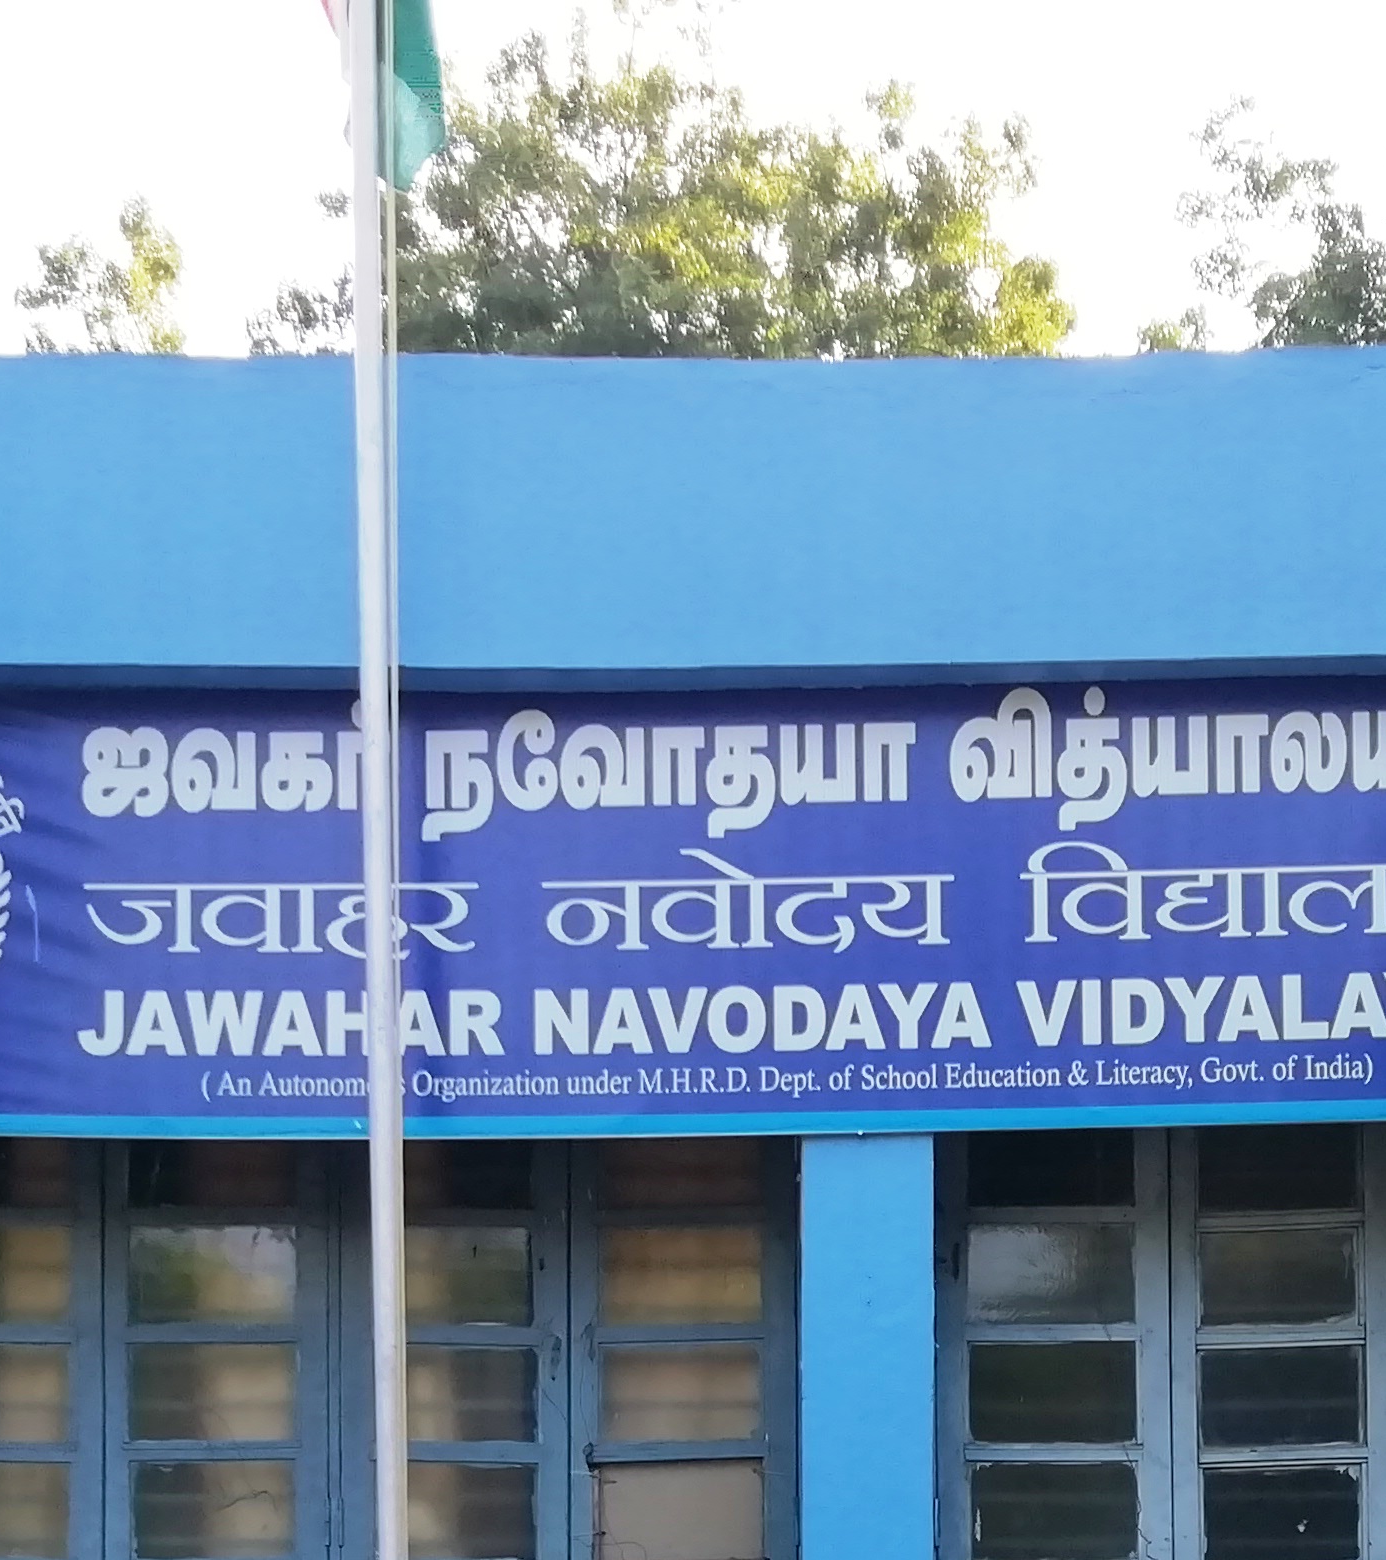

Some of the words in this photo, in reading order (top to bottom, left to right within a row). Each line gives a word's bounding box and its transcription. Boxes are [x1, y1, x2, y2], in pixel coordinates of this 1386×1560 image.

[421, 709, 916, 842] நவோதயா
[541, 848, 955, 954] नवोदय
[77, 988, 505, 1057] JAWAHAR
[533, 981, 992, 1056] NAVODAYA
[259, 1071, 406, 1098] Autonoms
[411, 1069, 560, 1103] Organization
[566, 1068, 633, 1095] under
[637, 1066, 751, 1095] M.H.R.D.
[759, 1065, 822, 1098] Dept.
[828, 1063, 855, 1091] of
[860, 1062, 939, 1092] School
[944, 1060, 1062, 1089] Education
[1067, 1060, 1091, 1087] &
[1095, 1057, 1194, 1091] Literacy,
[1200, 1056, 1265, 1083] Govt.
[1272, 1054, 1299, 1081] of
[1303, 1053, 1374, 1086] India)
